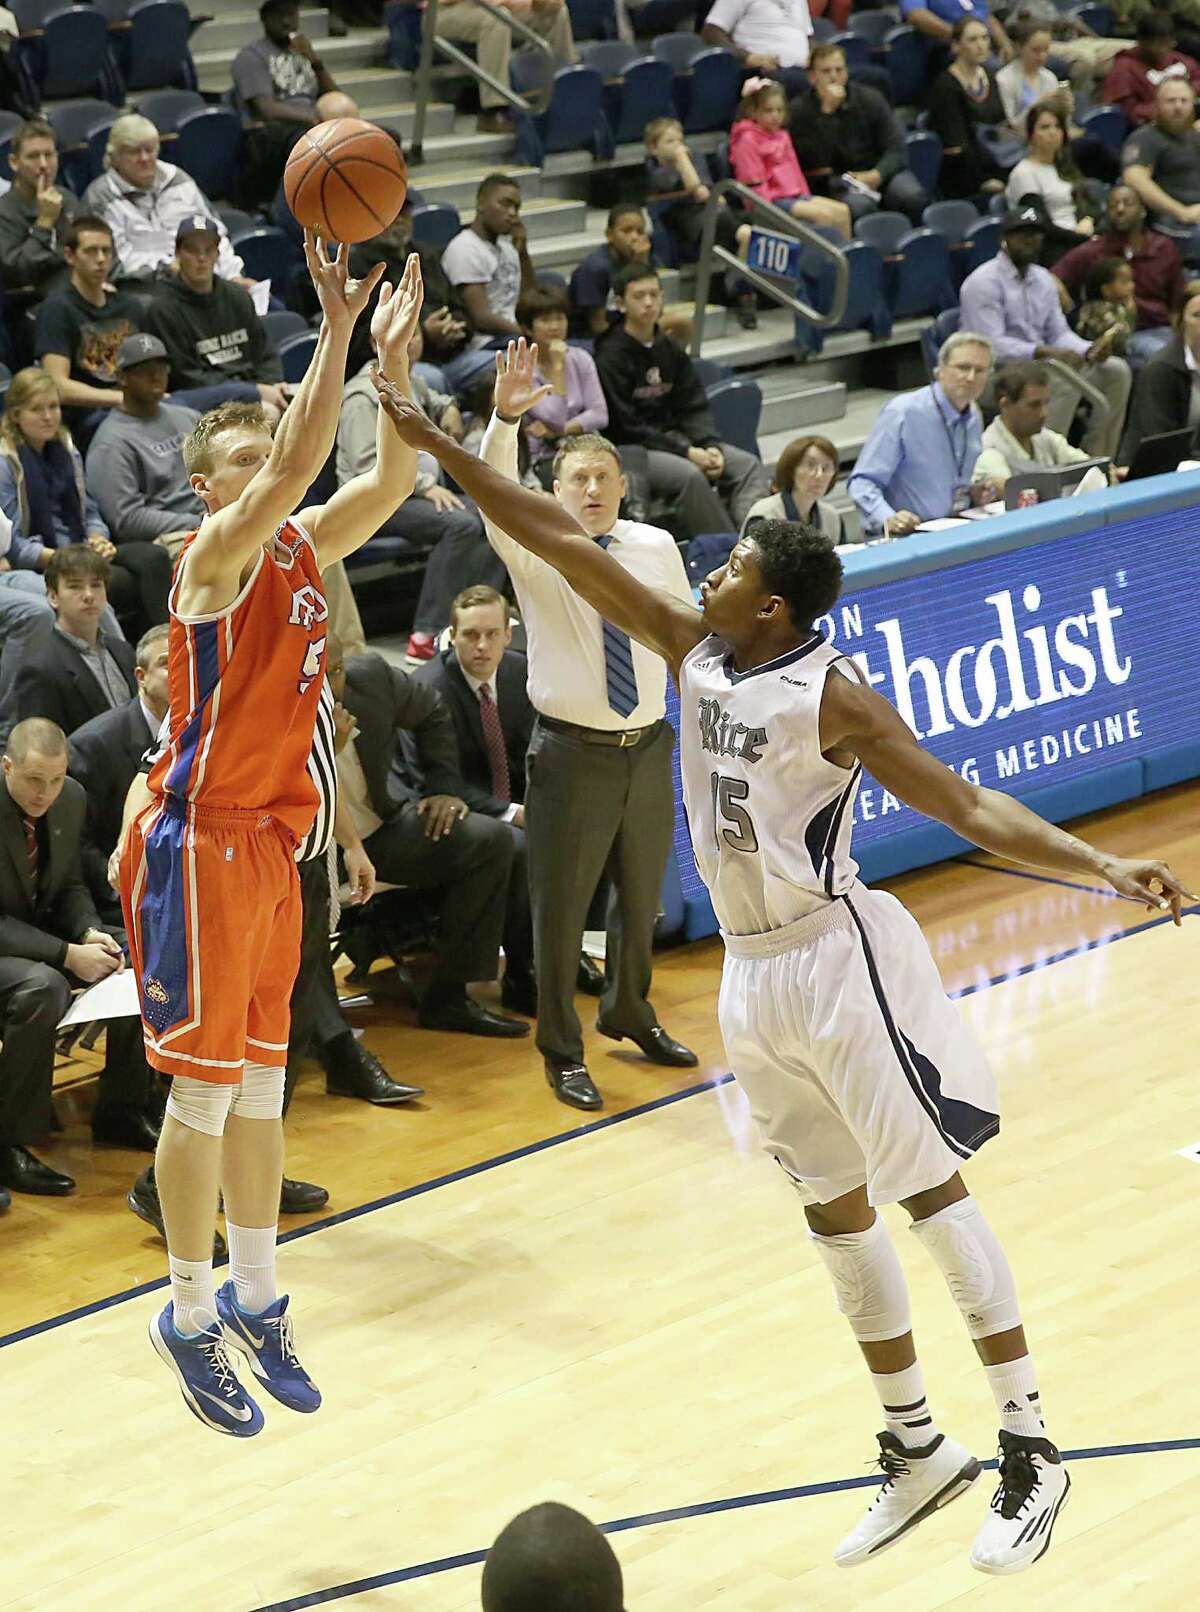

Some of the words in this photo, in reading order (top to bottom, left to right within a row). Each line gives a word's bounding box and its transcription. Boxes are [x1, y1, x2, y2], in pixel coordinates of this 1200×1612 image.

[757, 236, 790, 273] 110
[698, 697, 769, 764] Rice
[994, 708, 1143, 779] MEDICINE
[711, 771, 759, 853] 15
